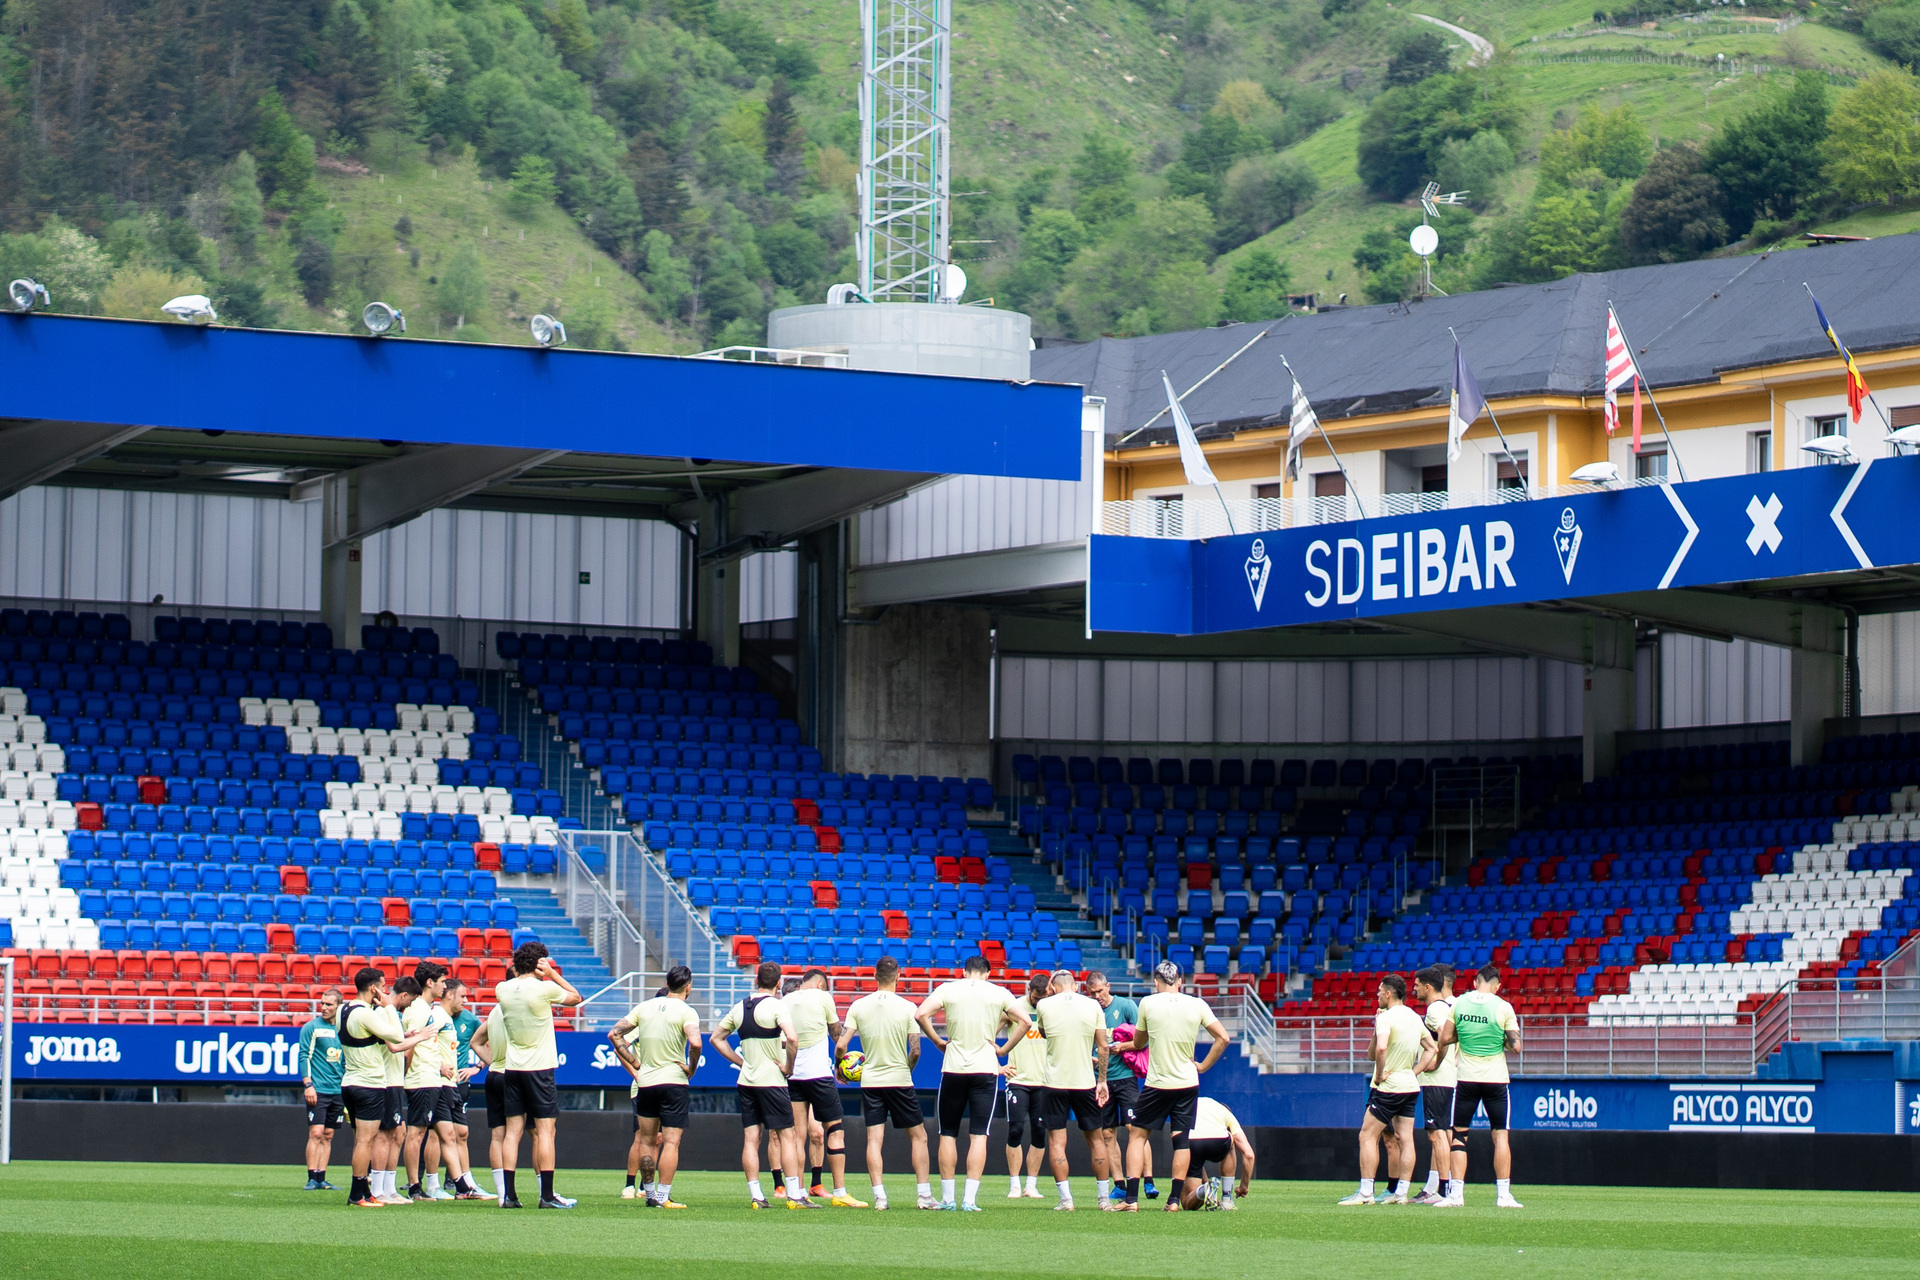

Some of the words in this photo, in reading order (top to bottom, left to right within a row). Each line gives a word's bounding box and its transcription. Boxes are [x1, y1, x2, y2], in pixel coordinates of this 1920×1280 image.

[1533, 1088, 1598, 1118] eibho
[1672, 1094, 1739, 1122] ALYCO
[1745, 1095, 1813, 1124] ALYCO
